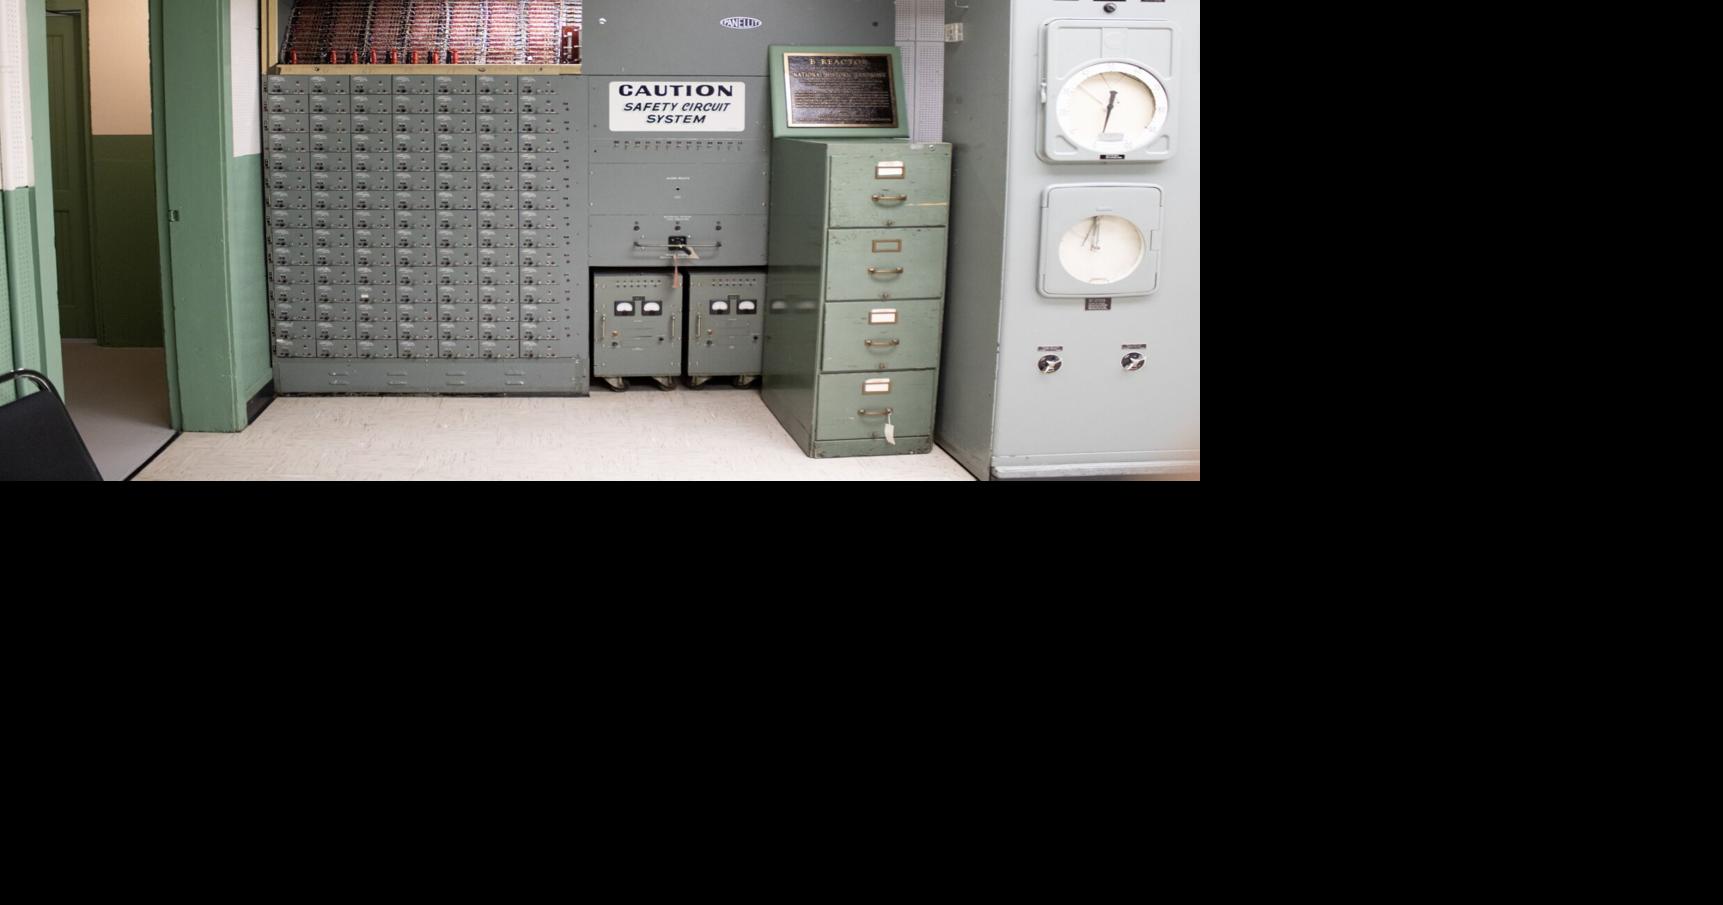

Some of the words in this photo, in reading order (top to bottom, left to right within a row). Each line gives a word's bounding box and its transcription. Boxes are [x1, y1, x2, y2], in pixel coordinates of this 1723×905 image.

[618, 84, 733, 97] CAUTION
[623, 102, 678, 112] SAFETY
[681, 102, 731, 112] CIRCUIT
[646, 114, 706, 124] SYSTEM
